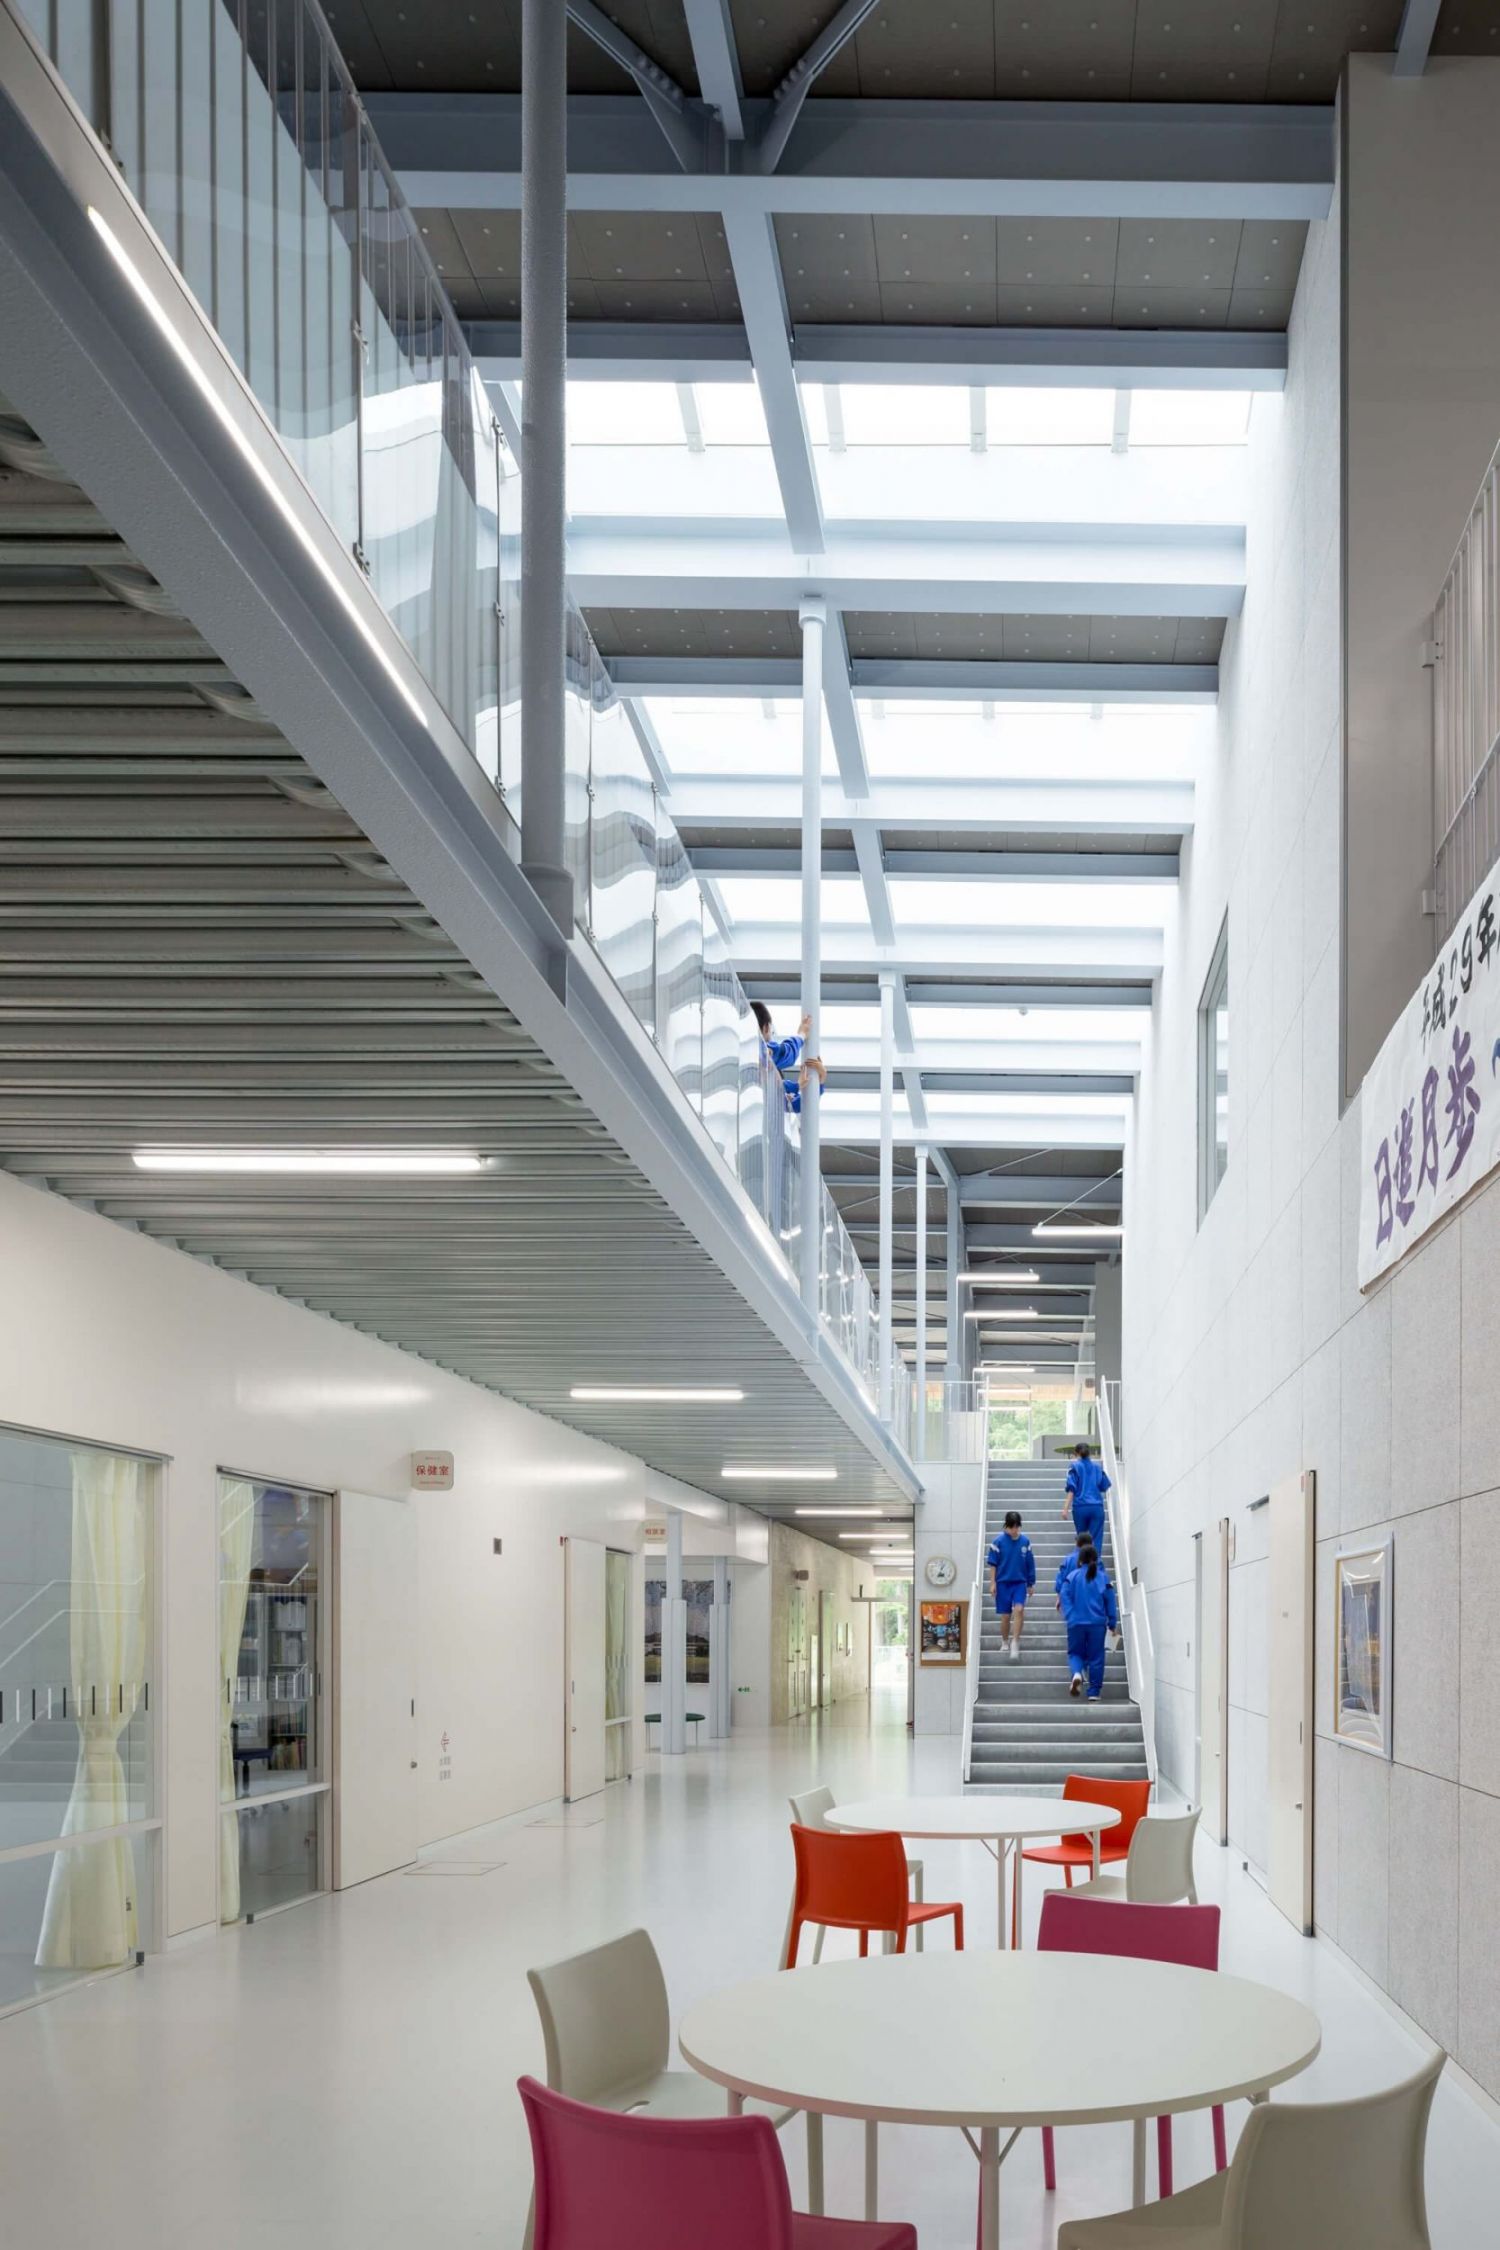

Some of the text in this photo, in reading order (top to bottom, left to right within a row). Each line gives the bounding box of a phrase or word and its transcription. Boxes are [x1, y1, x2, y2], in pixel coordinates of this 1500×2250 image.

[1421, 892, 1500, 1056] 平成29年
[1374, 1024, 1482, 1251] 日進月歩
[416, 1465, 449, 1476] 保健室
